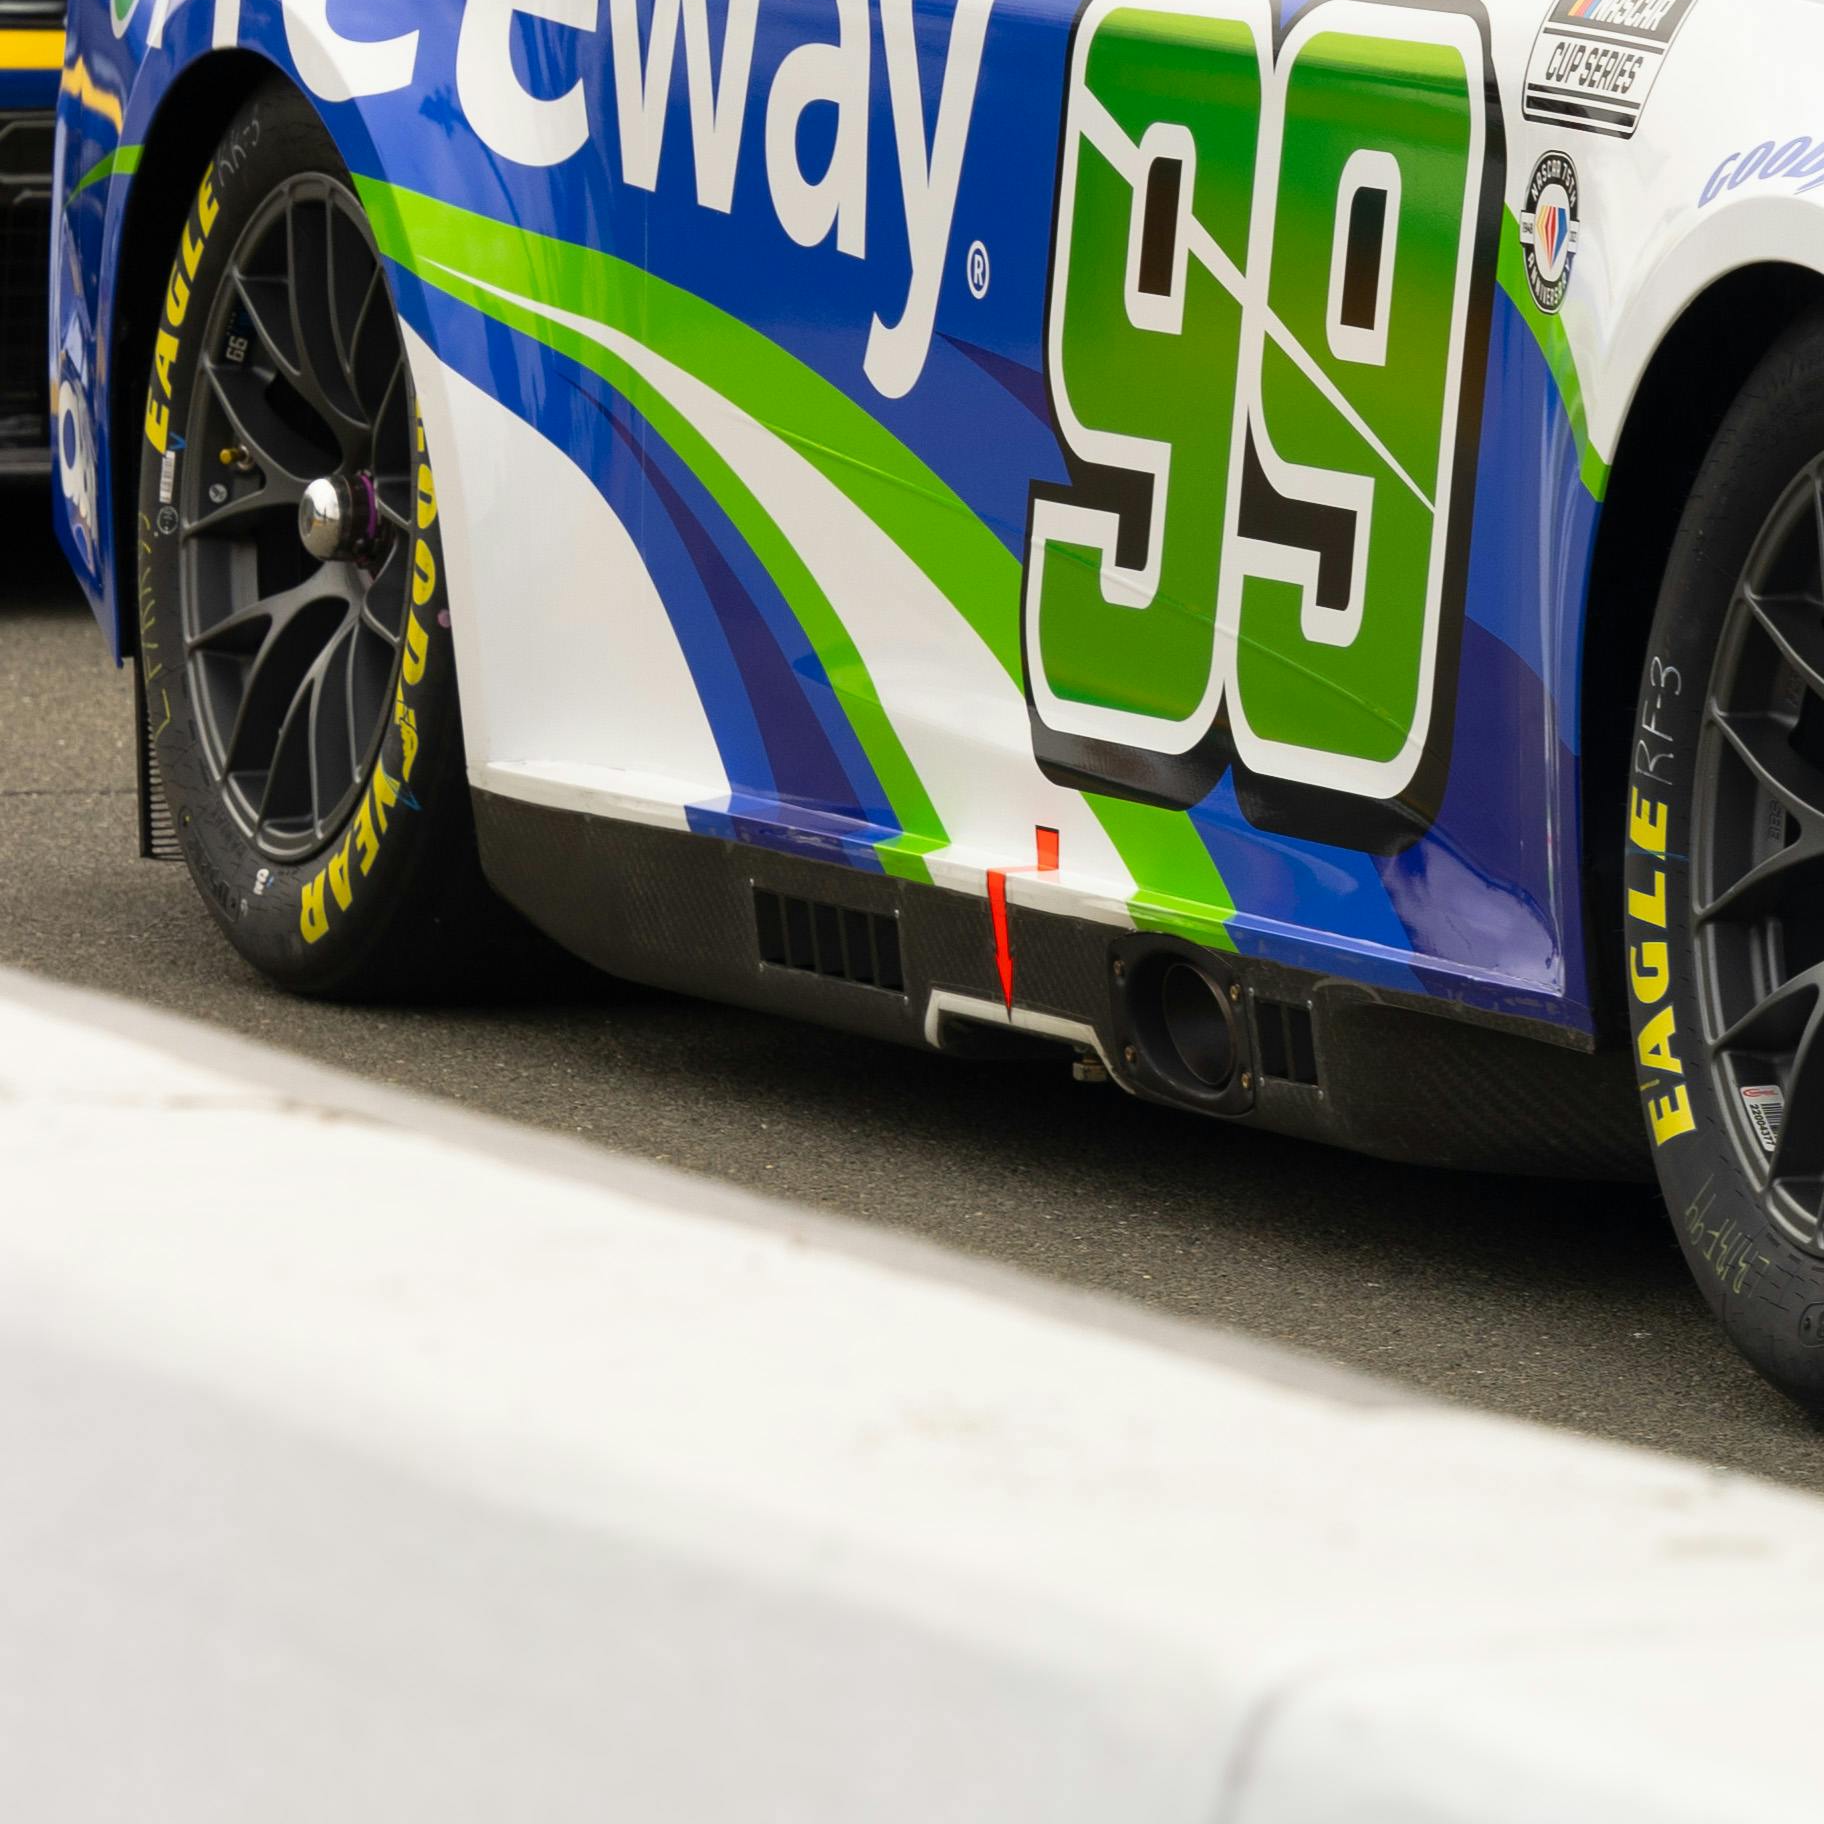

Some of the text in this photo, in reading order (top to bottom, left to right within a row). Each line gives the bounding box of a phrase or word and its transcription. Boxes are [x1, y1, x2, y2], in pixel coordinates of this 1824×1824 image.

[1545, 41, 1645, 95] CUP SERIES
[1530, 158, 1561, 203] NASCAR
[145, 160, 220, 455] EAGLE
[1527, 251, 1574, 308] ANNIVERSARY
[1634, 656, 1683, 786] RF-3
[1624, 786, 1697, 1147] EAGLE
